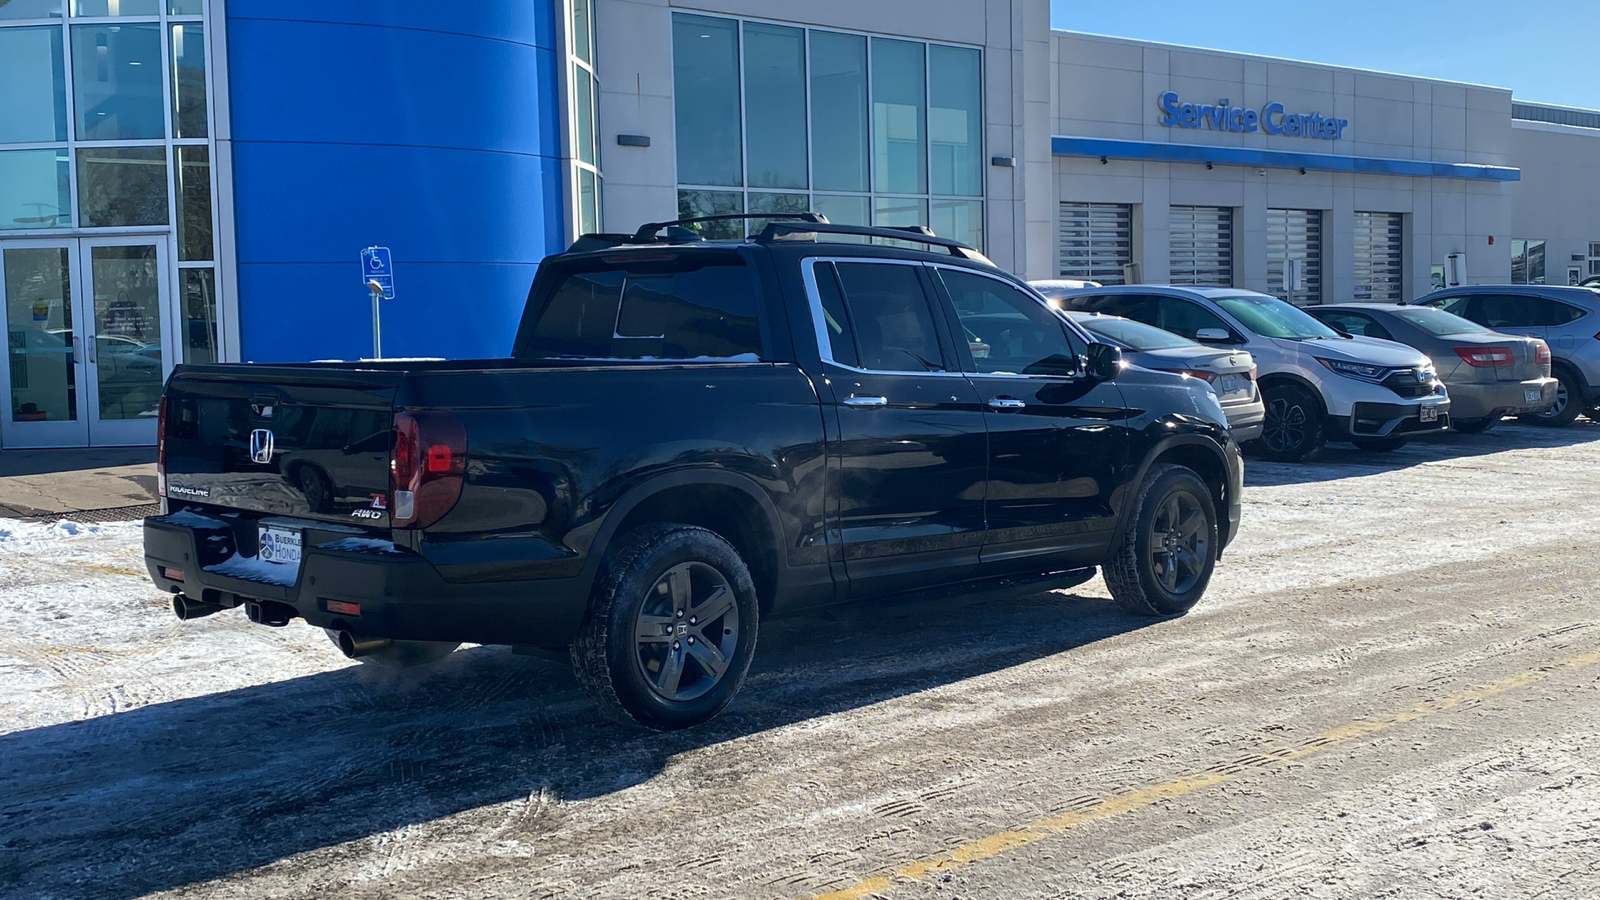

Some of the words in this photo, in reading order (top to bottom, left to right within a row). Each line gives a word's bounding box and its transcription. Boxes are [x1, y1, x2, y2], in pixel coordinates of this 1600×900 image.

[1159, 91, 1257, 132] Service
[1262, 102, 1347, 139] Center
[351, 509, 382, 519] AWD
